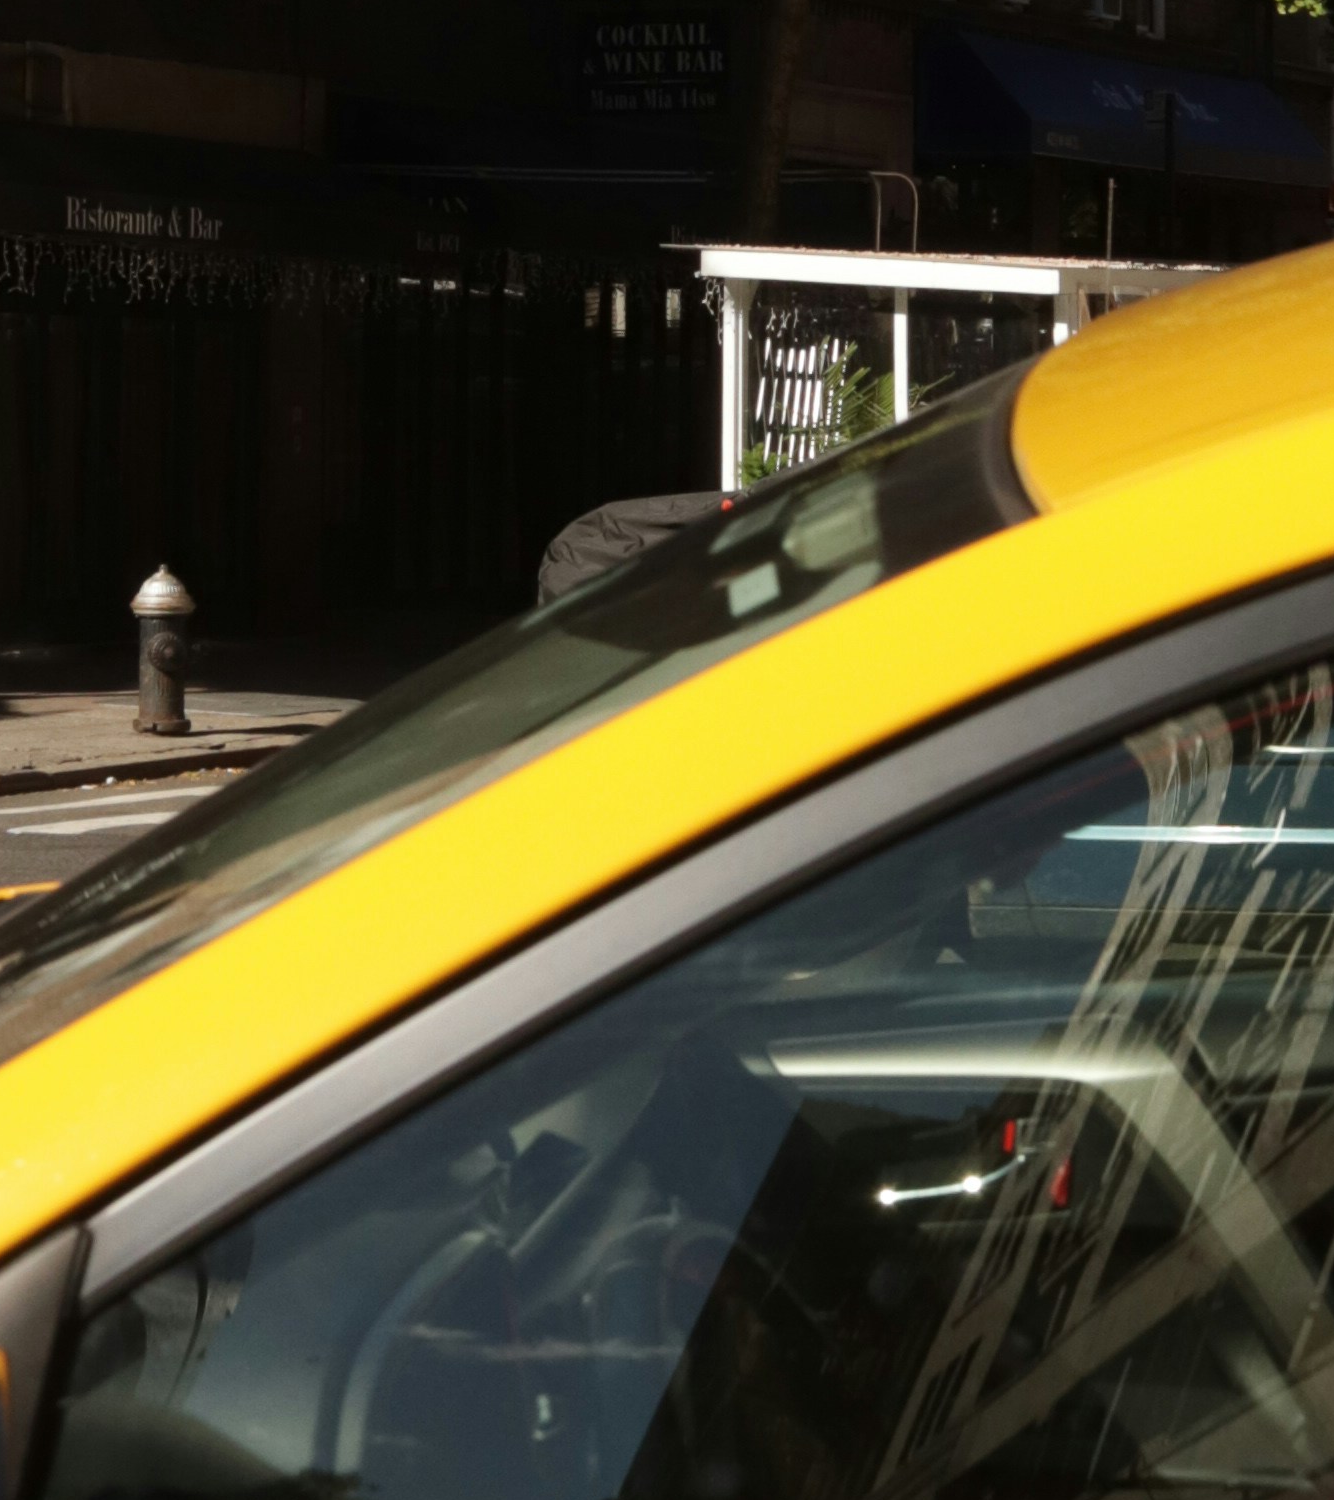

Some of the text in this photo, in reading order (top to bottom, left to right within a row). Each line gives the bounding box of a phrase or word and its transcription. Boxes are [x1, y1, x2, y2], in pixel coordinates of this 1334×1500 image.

[595, 22, 712, 48] COCKTAIL
[603, 50, 666, 74] WINE
[676, 49, 724, 73] BAR
[65, 195, 224, 241] Ristorante & Bar
